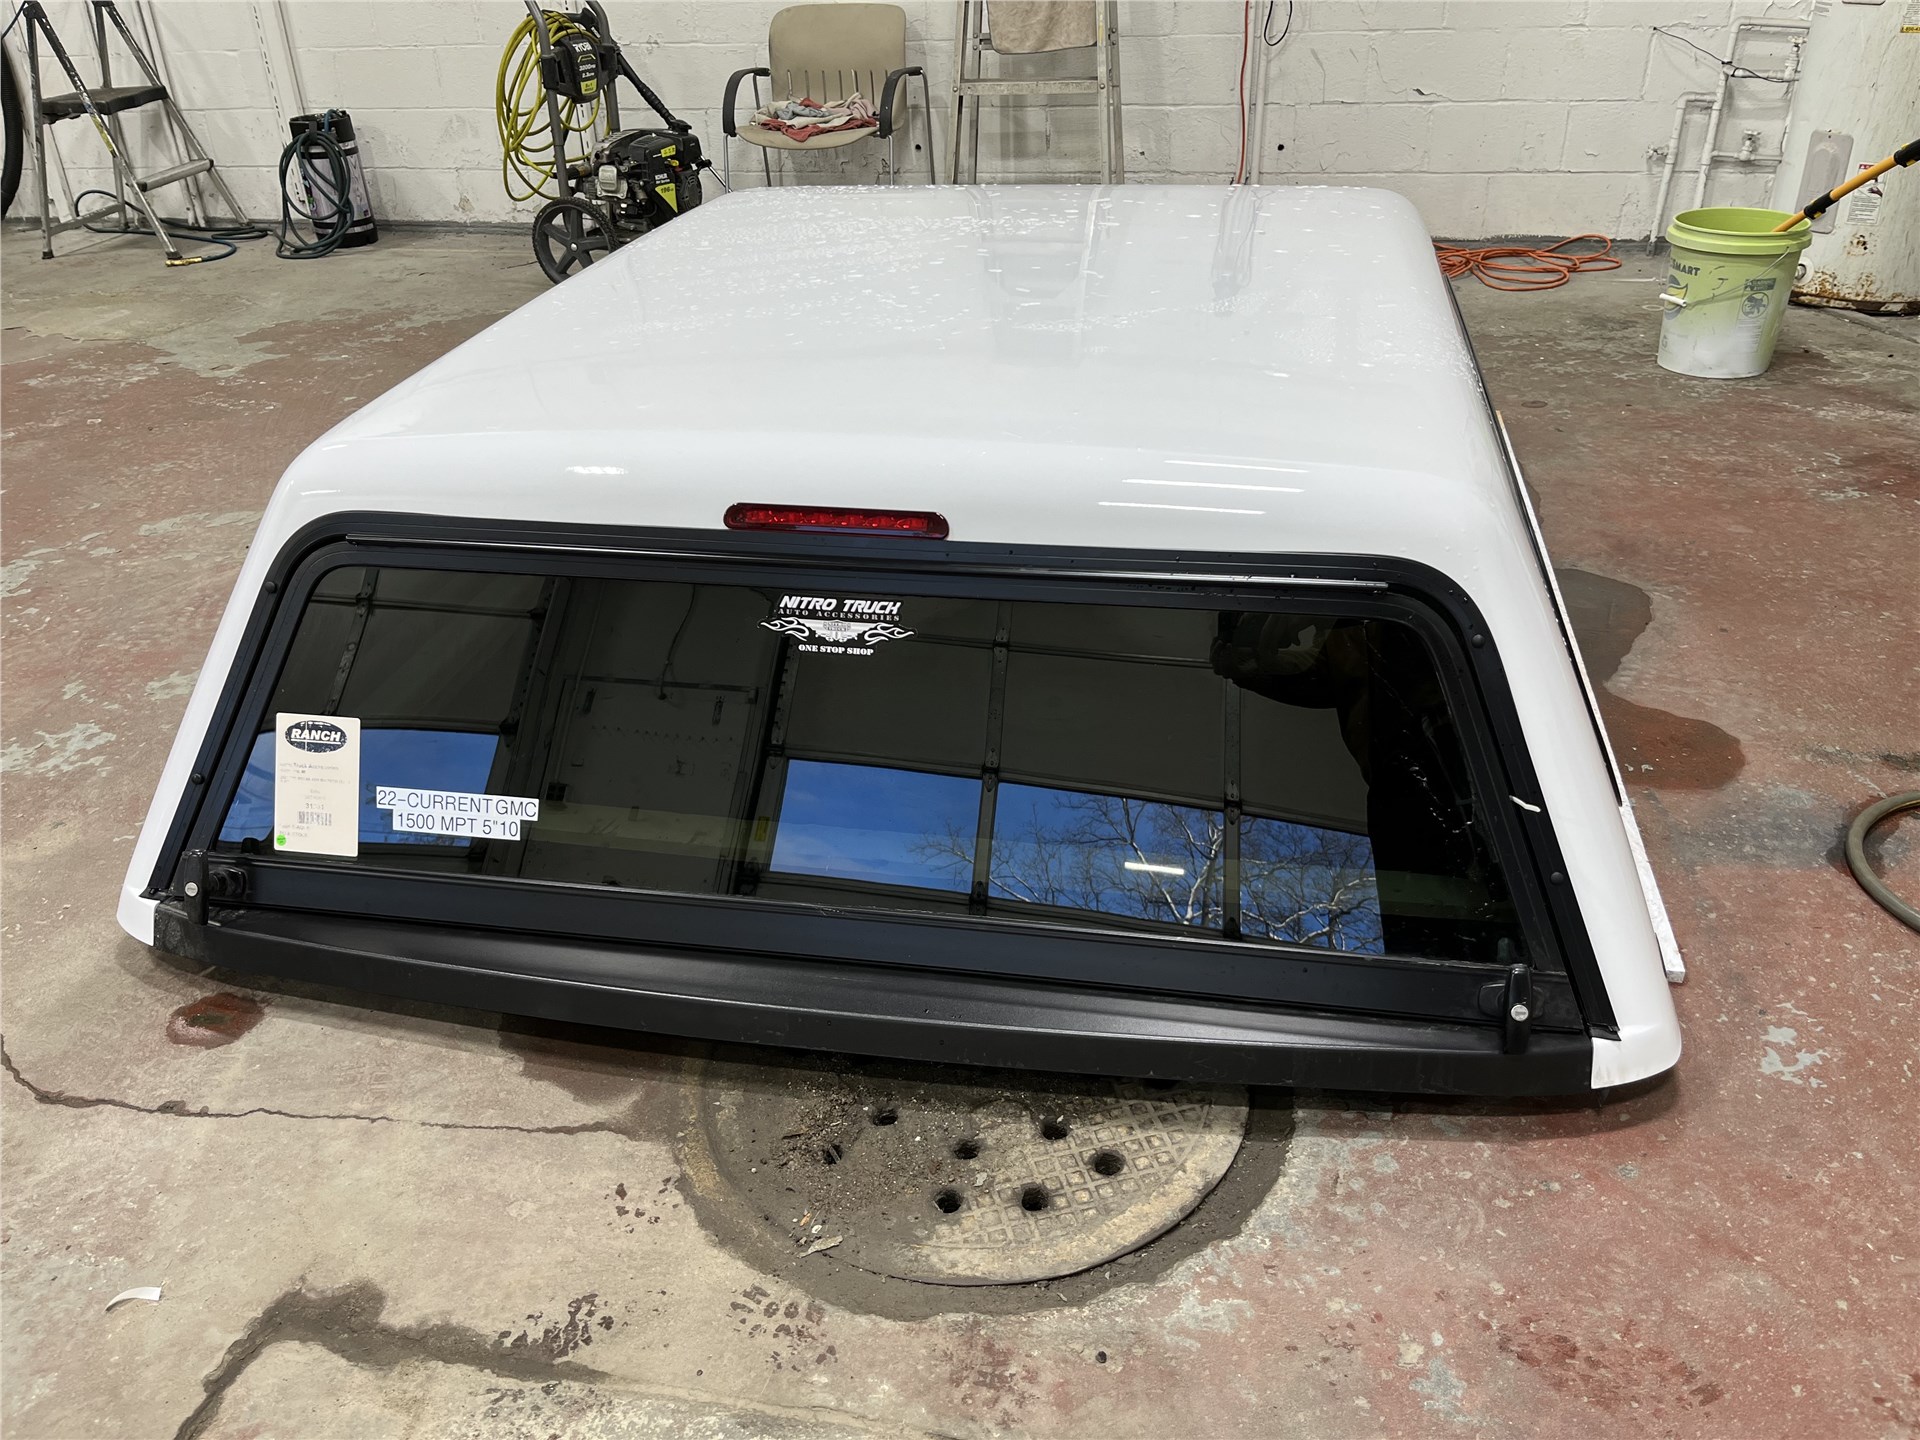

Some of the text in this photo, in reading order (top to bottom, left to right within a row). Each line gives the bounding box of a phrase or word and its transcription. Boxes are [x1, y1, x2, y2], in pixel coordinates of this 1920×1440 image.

[572, 41, 593, 53] RYOBI
[779, 594, 902, 615] NITRO TRUCK
[778, 607, 900, 622] AUTO ACCESSORIES
[798, 643, 874, 656] ONE STOP SHOP
[290, 728, 342, 743] RANCH
[377, 789, 537, 818] 22-CURRENT GMC
[397, 813, 519, 837] 1500 MPT 5"10
